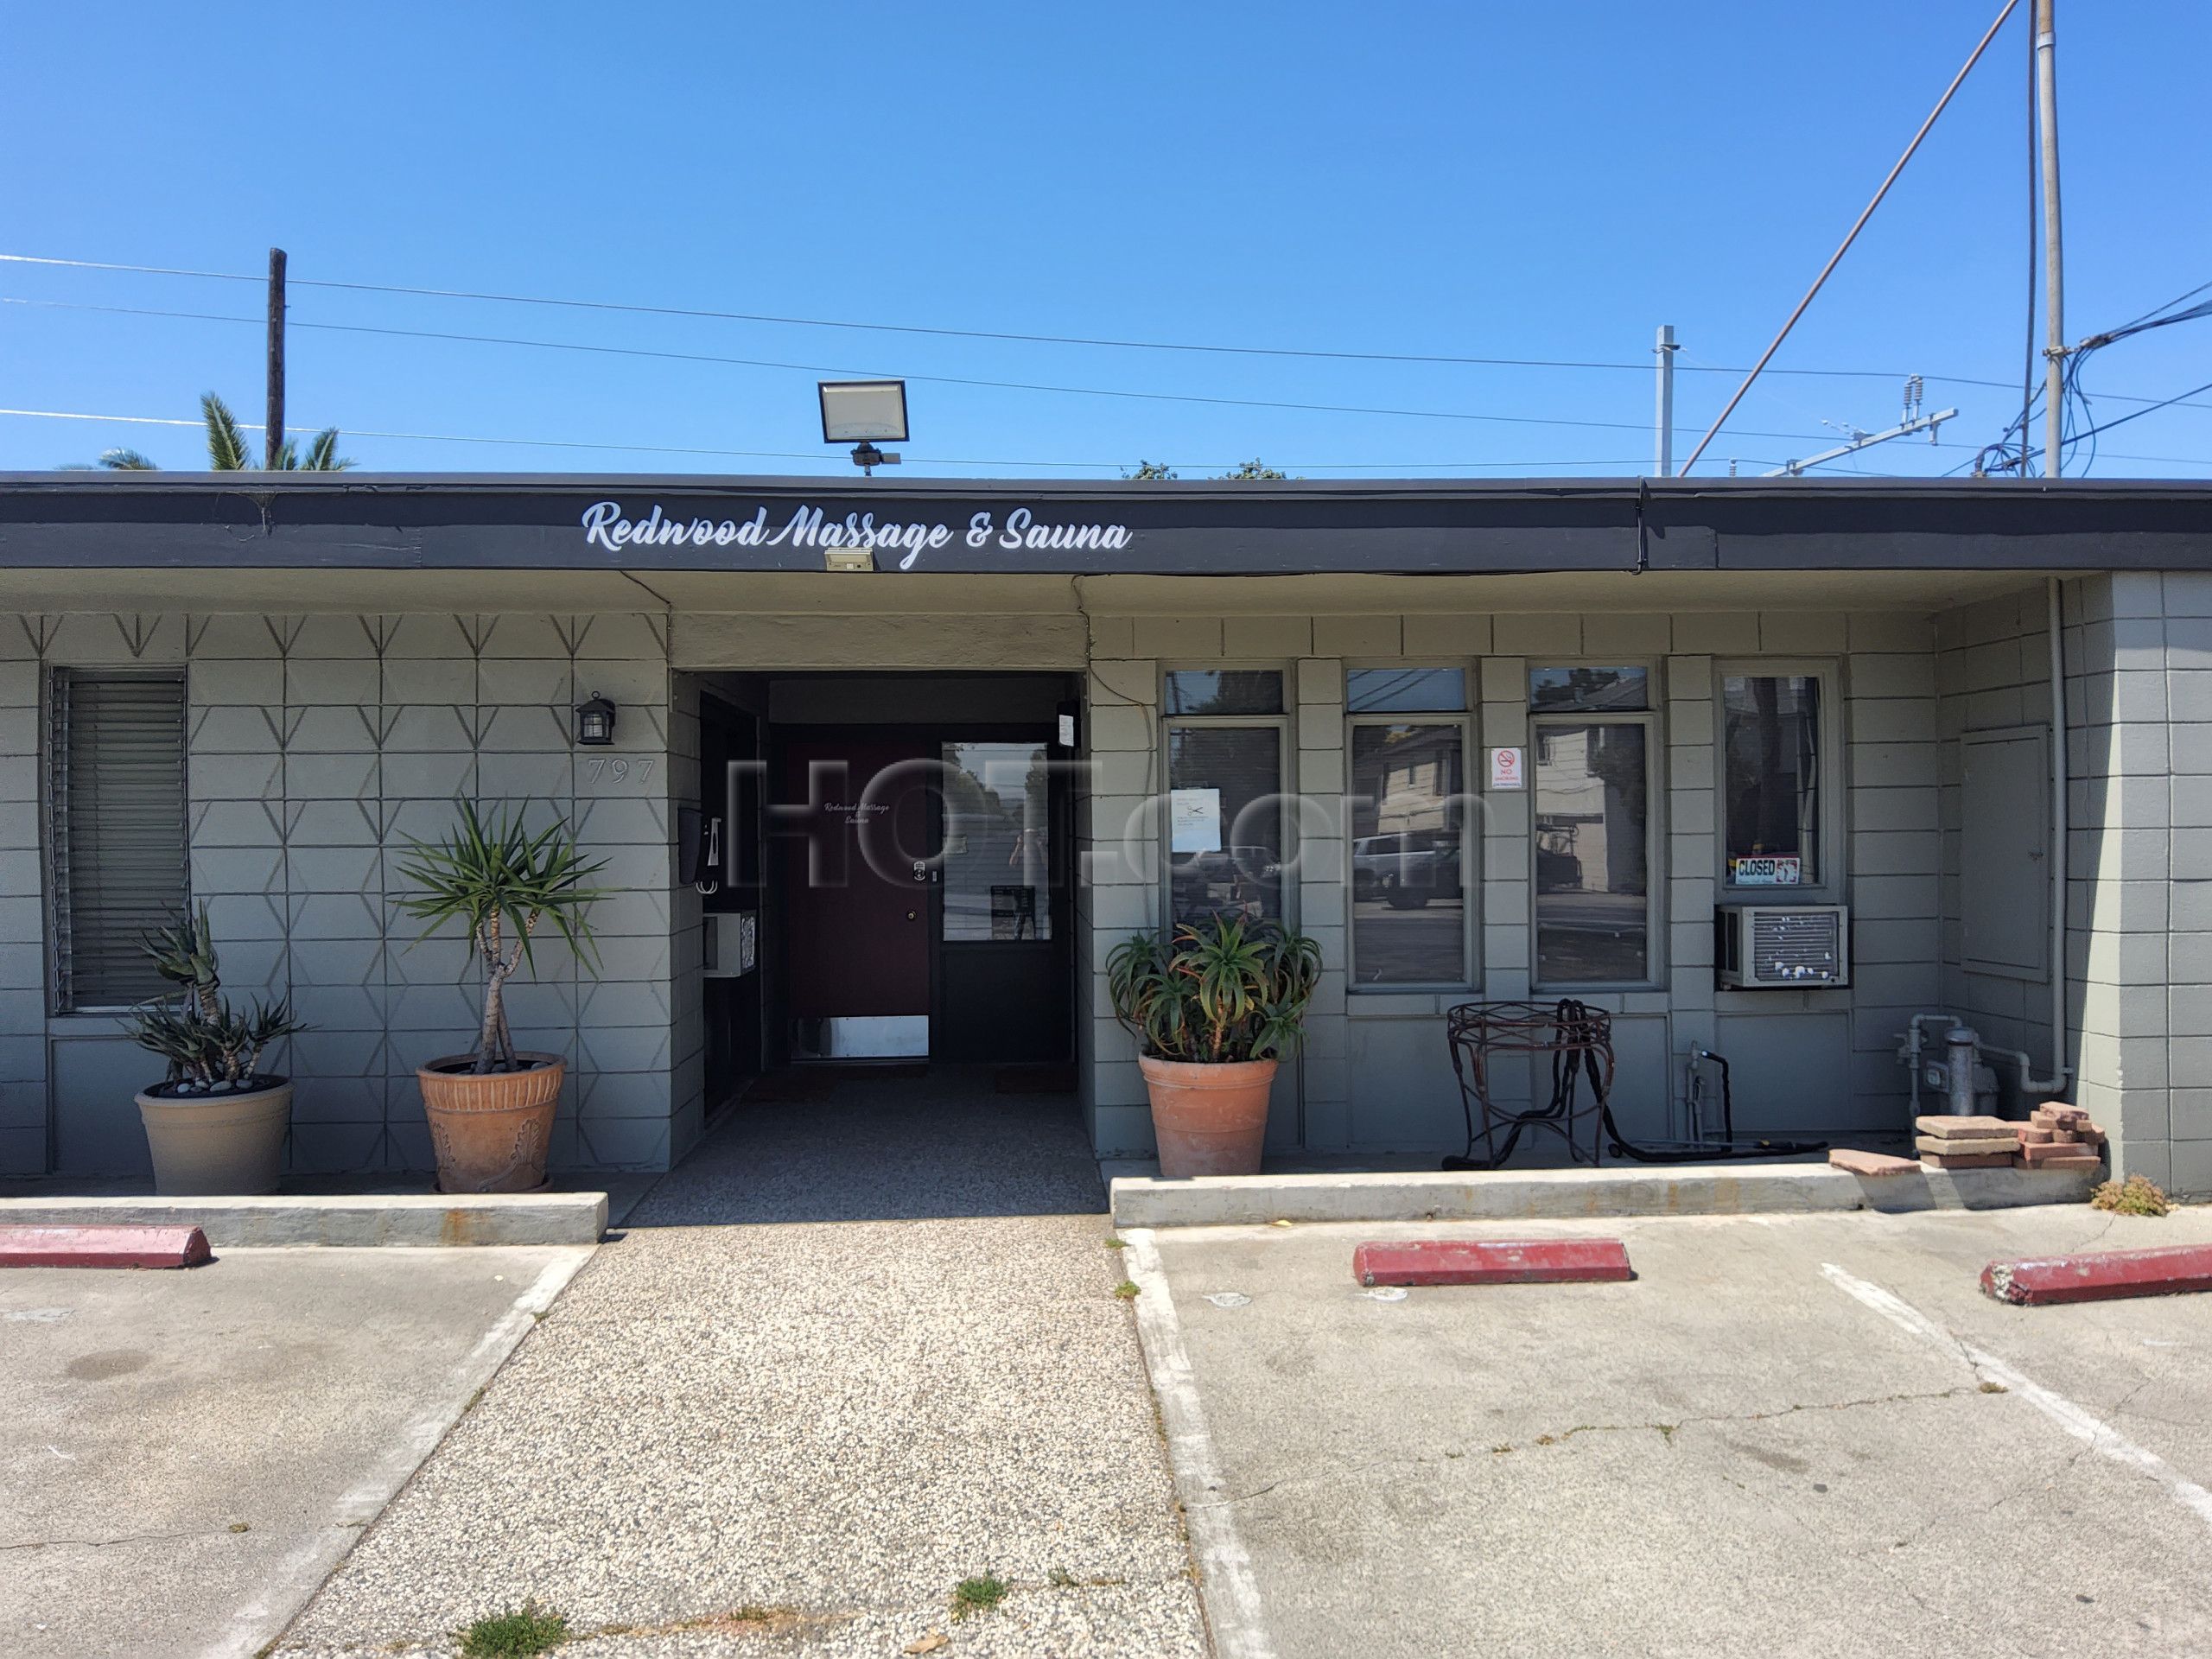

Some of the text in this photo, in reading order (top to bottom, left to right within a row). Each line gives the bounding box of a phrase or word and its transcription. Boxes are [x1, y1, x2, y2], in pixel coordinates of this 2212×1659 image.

[582, 501, 1133, 570] Redwood Massage & Sauna
[588, 759, 654, 784] 797
[1738, 859, 1776, 876] CLOSED
